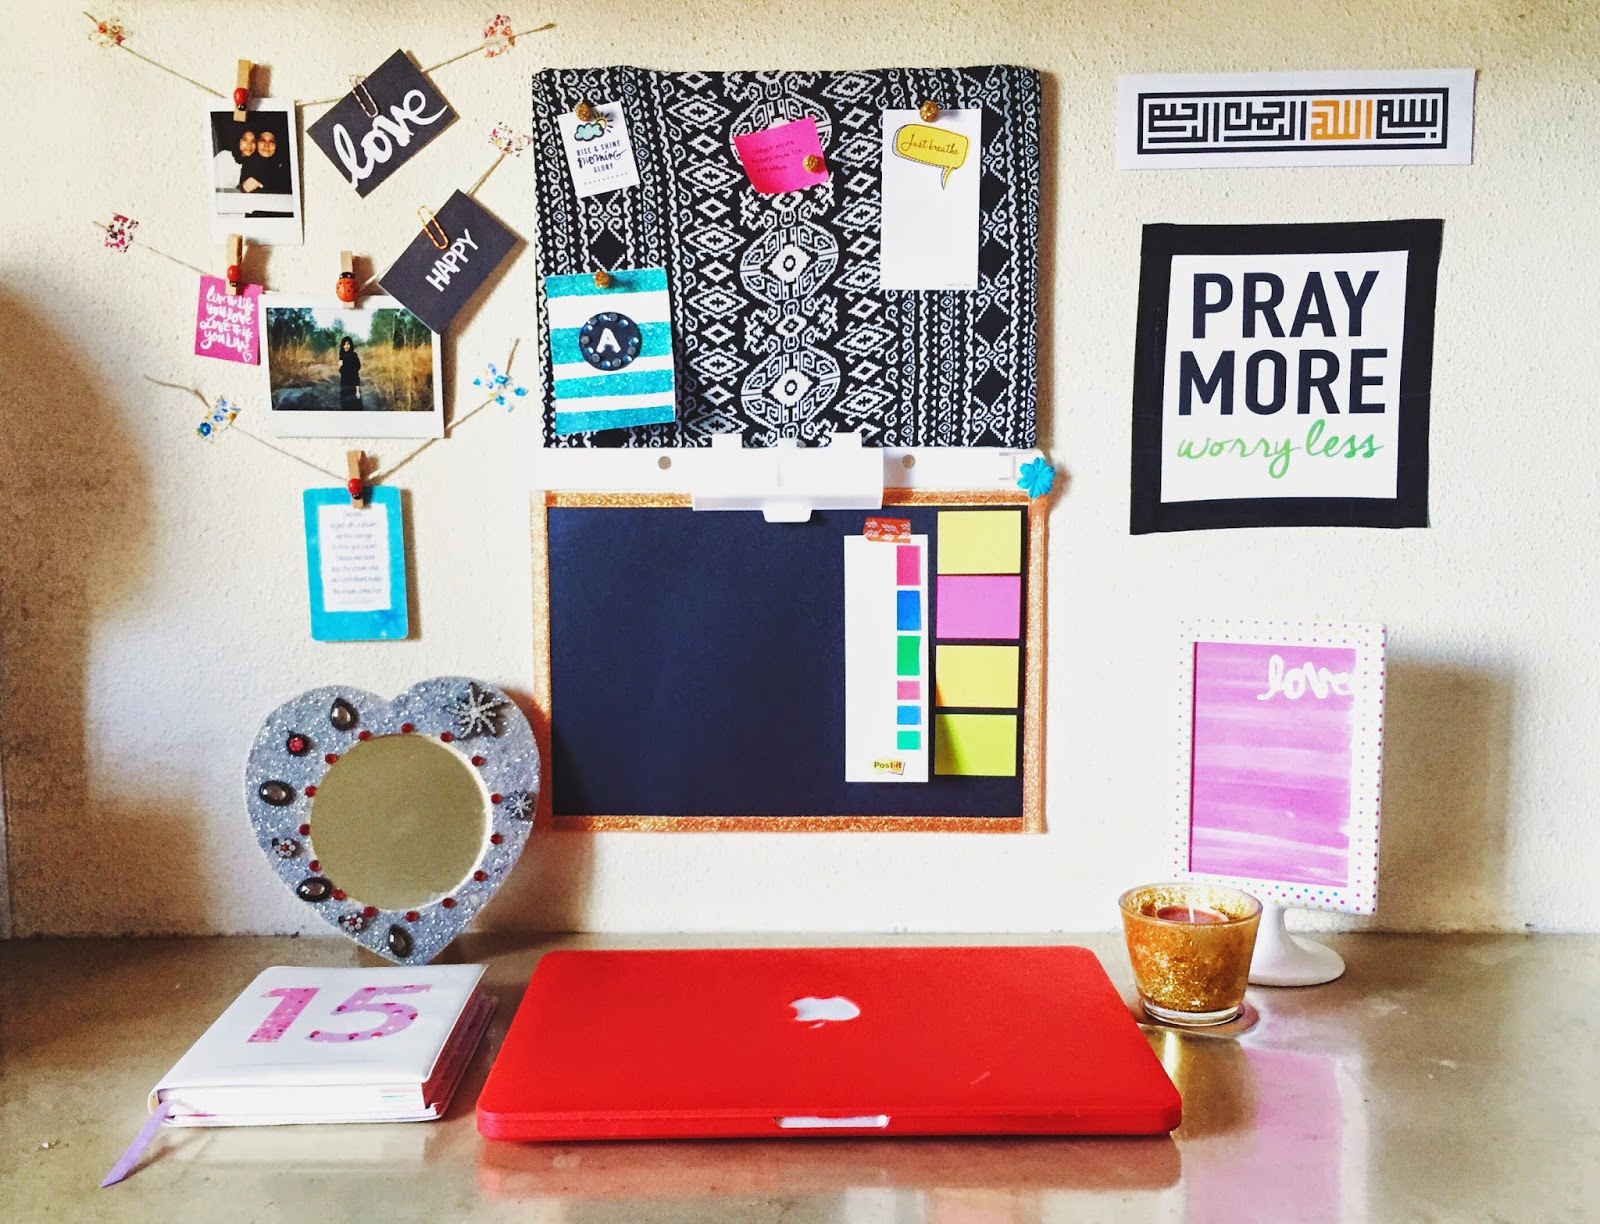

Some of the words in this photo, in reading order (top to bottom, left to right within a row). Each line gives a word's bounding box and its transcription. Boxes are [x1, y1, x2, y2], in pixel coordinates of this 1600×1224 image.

[333, 89, 448, 186] love
[1311, 99, 1373, 141] الله
[593, 162, 614, 173] GLORY
[600, 140, 622, 151] SHINE
[901, 133, 928, 152] Just
[928, 140, 960, 156] breathe
[425, 229, 479, 292] HAPPY
[1192, 270, 1380, 339] PRAY
[596, 327, 622, 354] A
[1178, 347, 1388, 416] MORE
[1177, 436, 1302, 479] worry
[1305, 418, 1385, 459] less
[1256, 654, 1354, 701] love
[873, 761, 902, 769] Post-it
[246, 983, 433, 1043] 15
